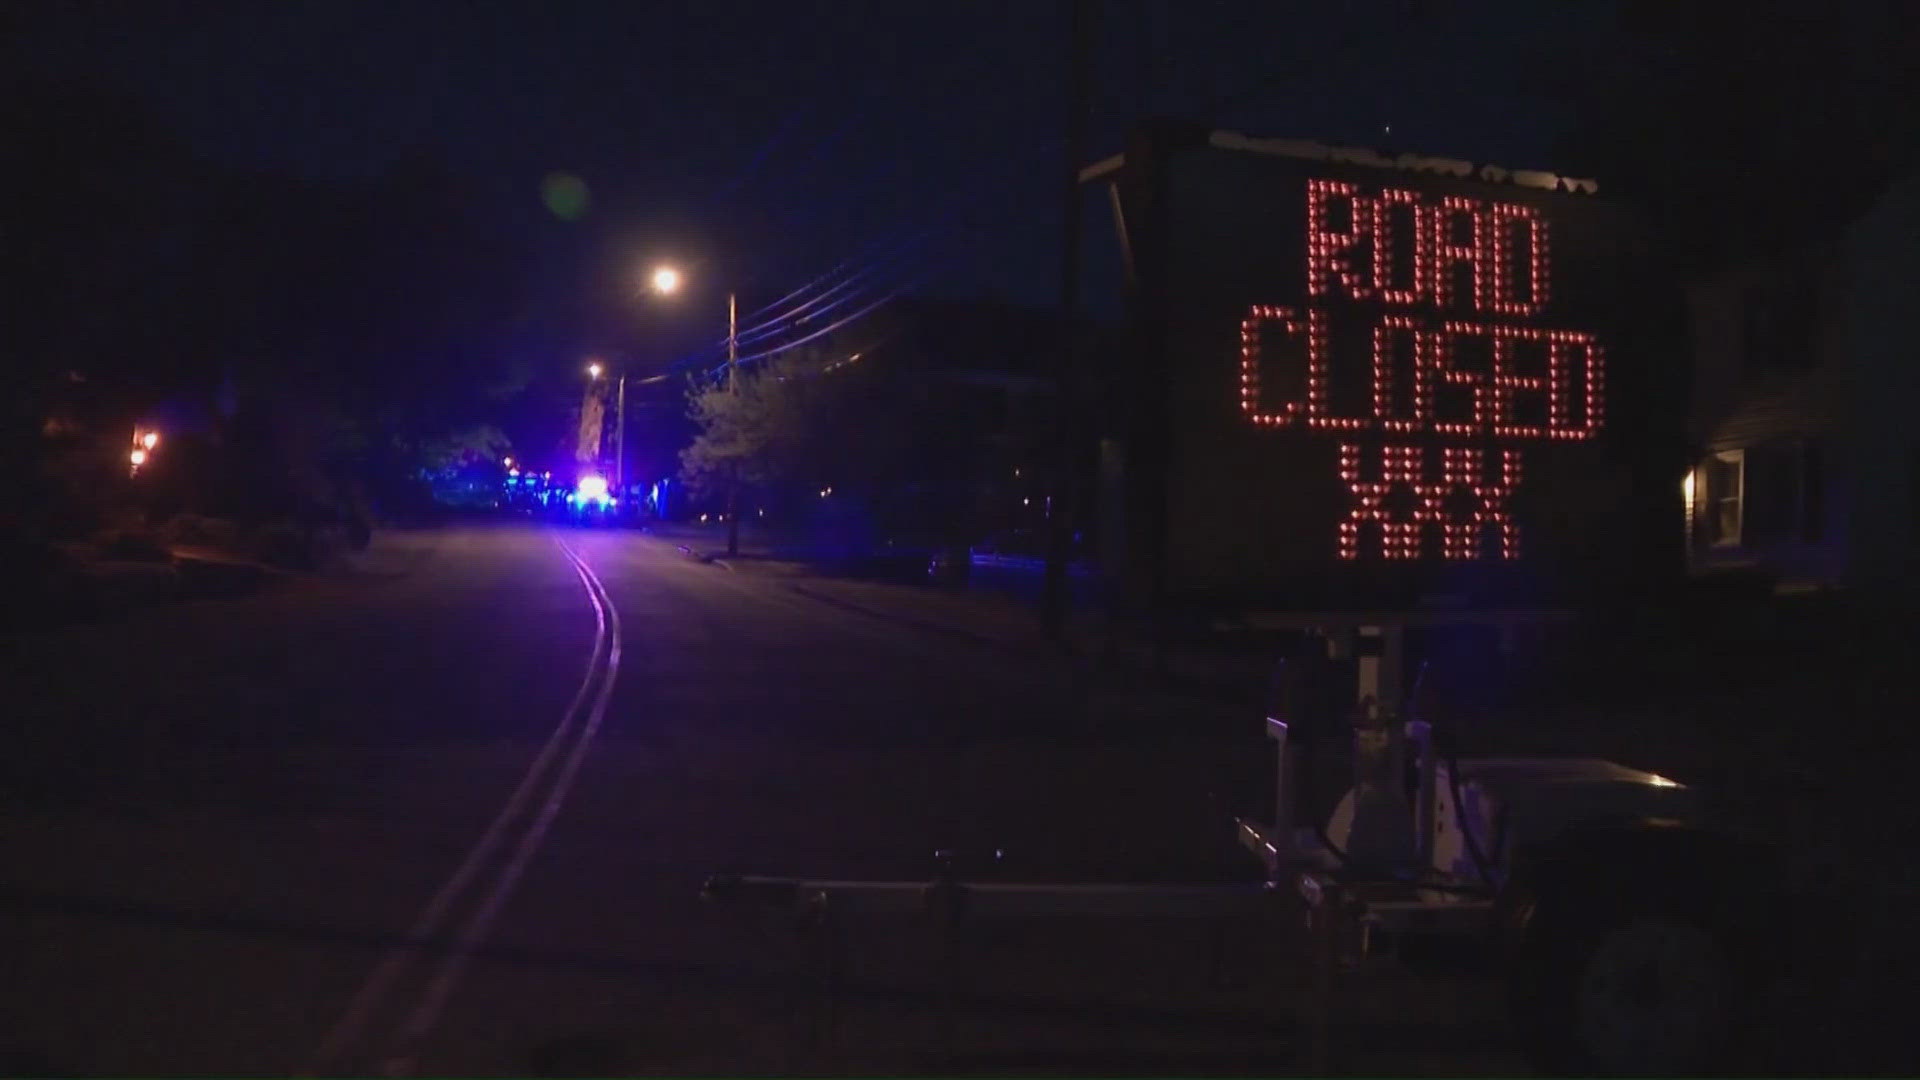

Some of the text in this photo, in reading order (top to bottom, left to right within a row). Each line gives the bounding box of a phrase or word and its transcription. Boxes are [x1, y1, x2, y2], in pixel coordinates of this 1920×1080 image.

[1308, 178, 1550, 316] ROAD
[1240, 304, 1605, 439] CLOSED
[1338, 442, 1522, 560] XXX
